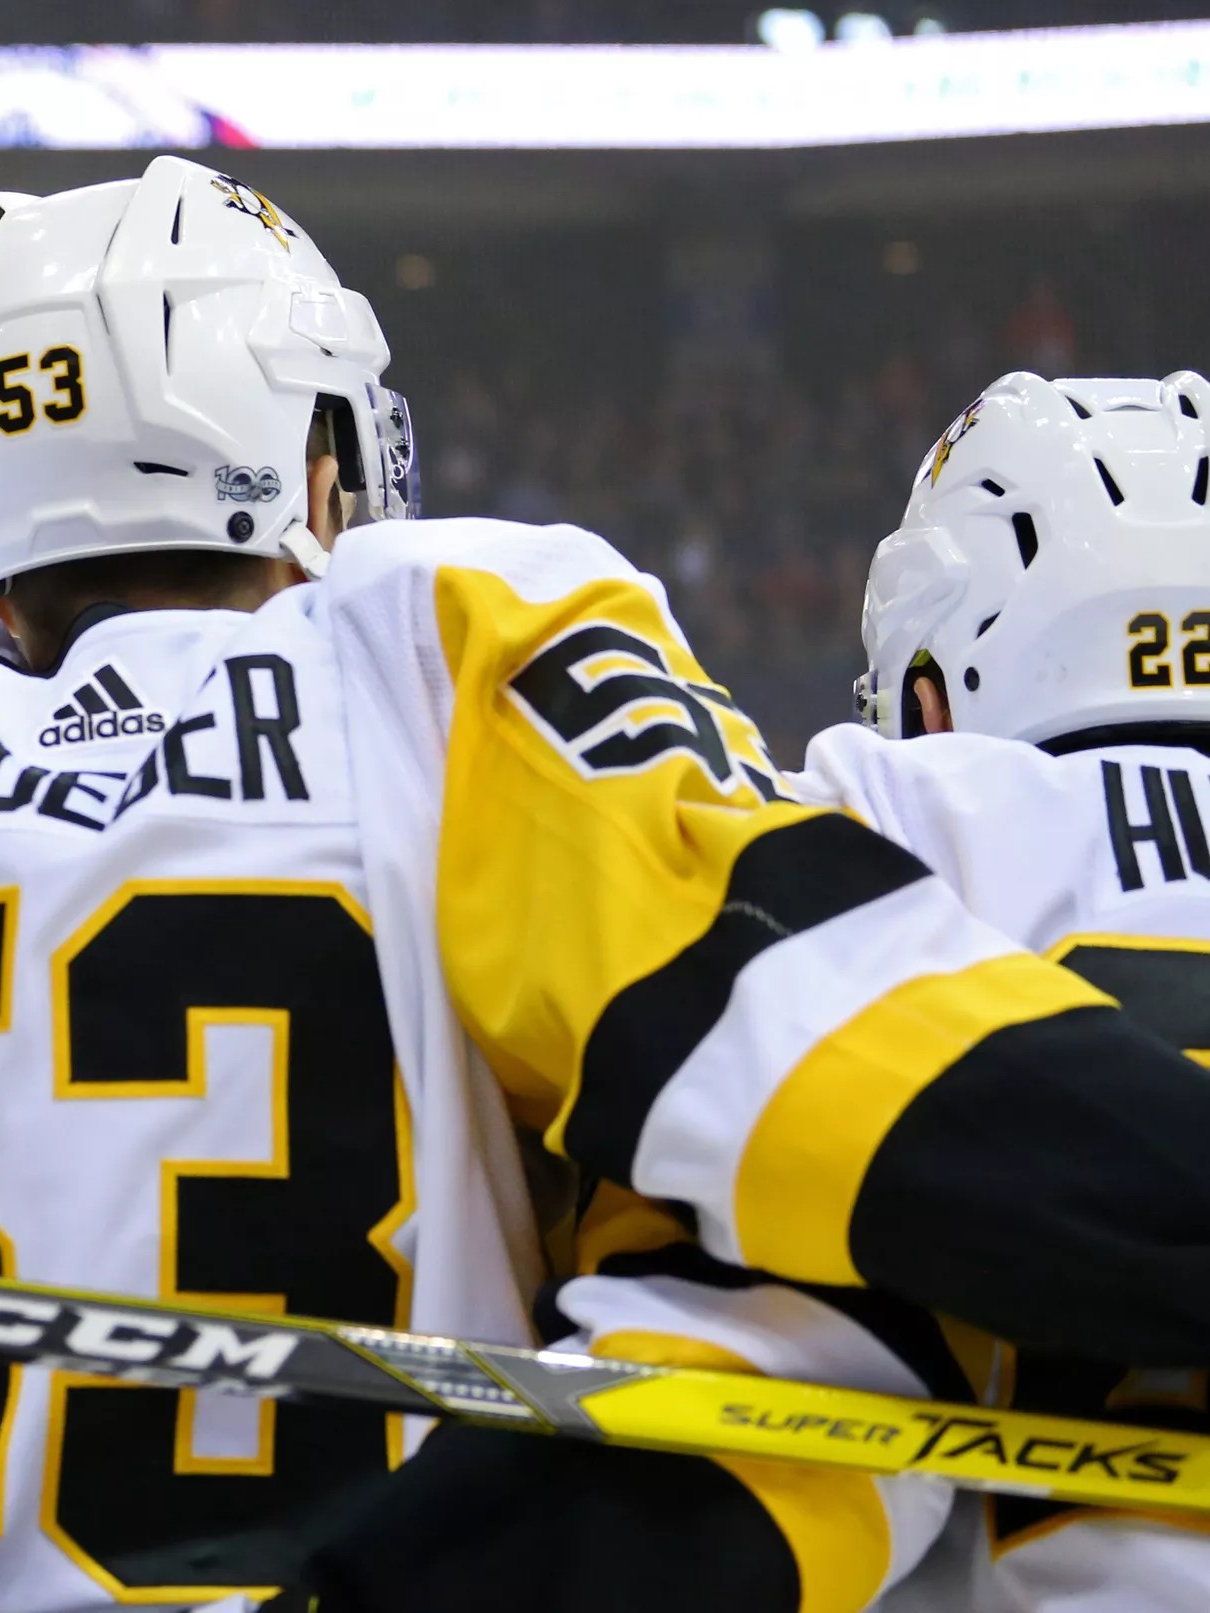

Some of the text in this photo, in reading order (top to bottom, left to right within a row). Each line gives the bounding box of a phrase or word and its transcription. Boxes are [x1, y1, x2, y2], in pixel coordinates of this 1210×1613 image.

[1127, 610, 1210, 690] 22
[38, 708, 167, 748] adidas
[498, 618, 802, 804] 5
[719, 1403, 1189, 1485] SUPER TACKS
